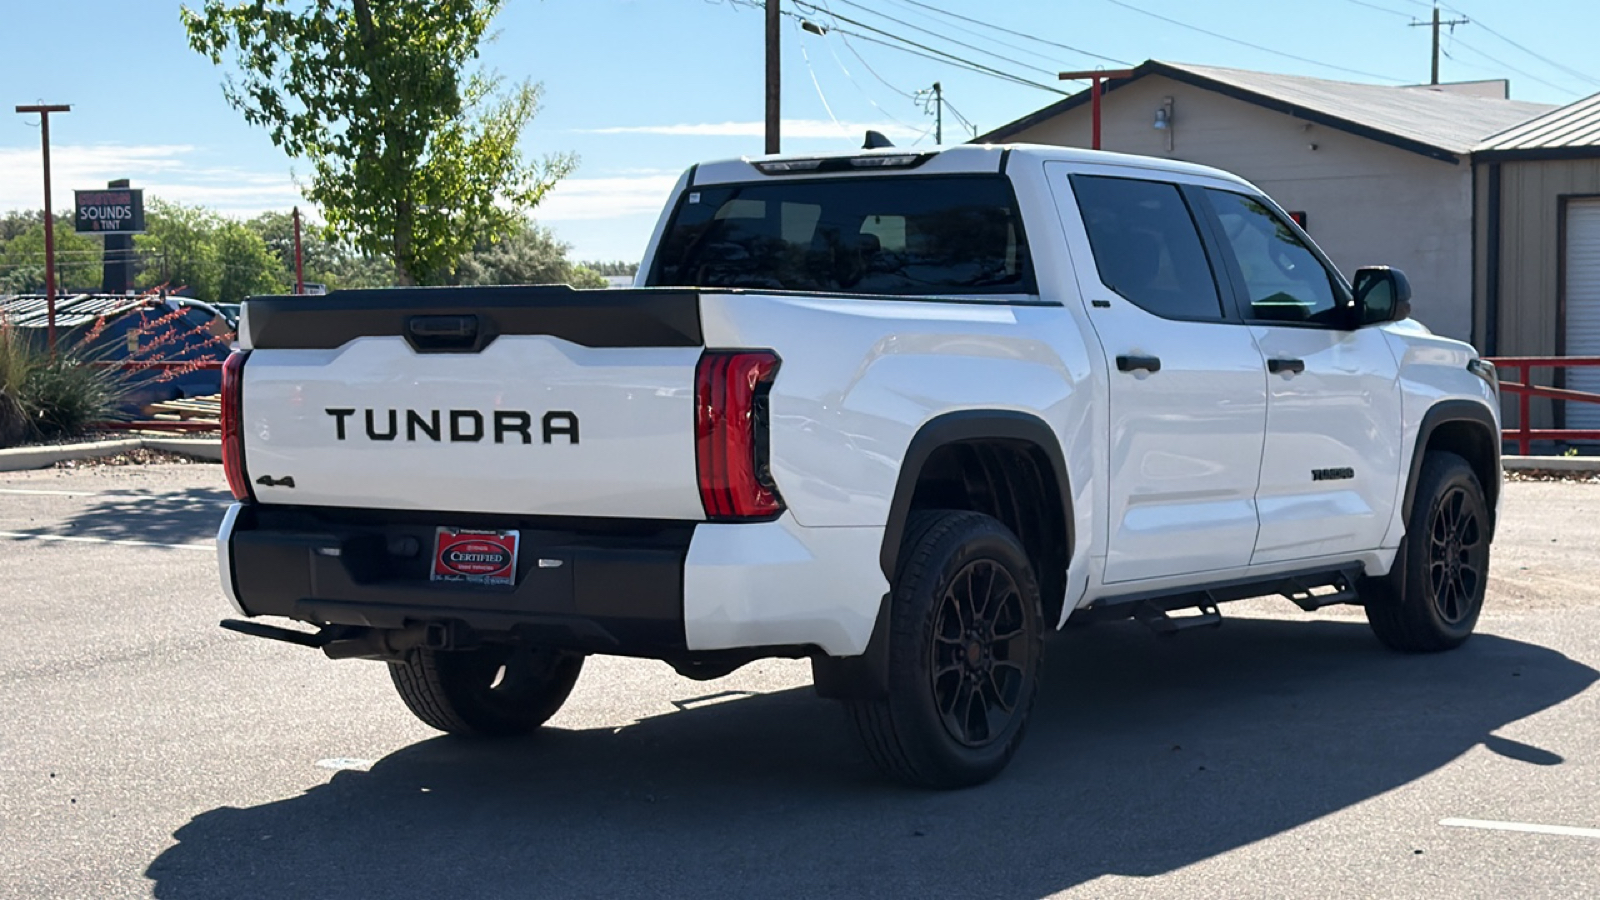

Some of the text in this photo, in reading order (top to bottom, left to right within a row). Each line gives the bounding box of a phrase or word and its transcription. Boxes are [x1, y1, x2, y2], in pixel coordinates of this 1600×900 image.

[80, 205, 132, 220] SOUNDS
[100, 220, 120, 230] TINT
[325, 408, 580, 445] TUNDRA
